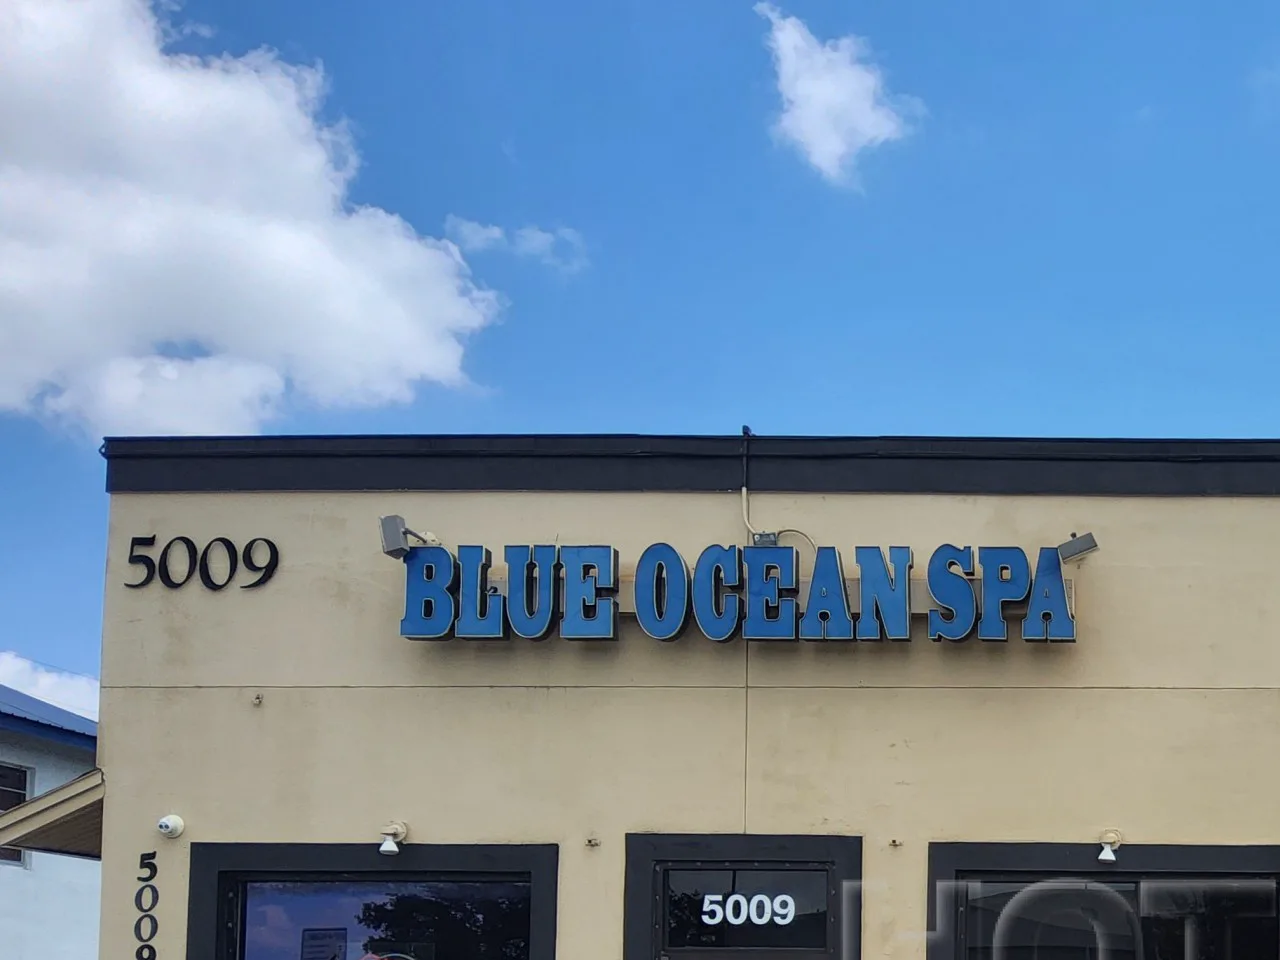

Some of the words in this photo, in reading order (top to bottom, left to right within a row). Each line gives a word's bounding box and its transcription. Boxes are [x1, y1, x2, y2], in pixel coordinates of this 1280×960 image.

[124, 534, 279, 591] 5009
[399, 544, 616, 641] BLUE
[633, 541, 914, 641] OCEAN
[927, 543, 1076, 642] SPA
[701, 894, 795, 925] 5009
